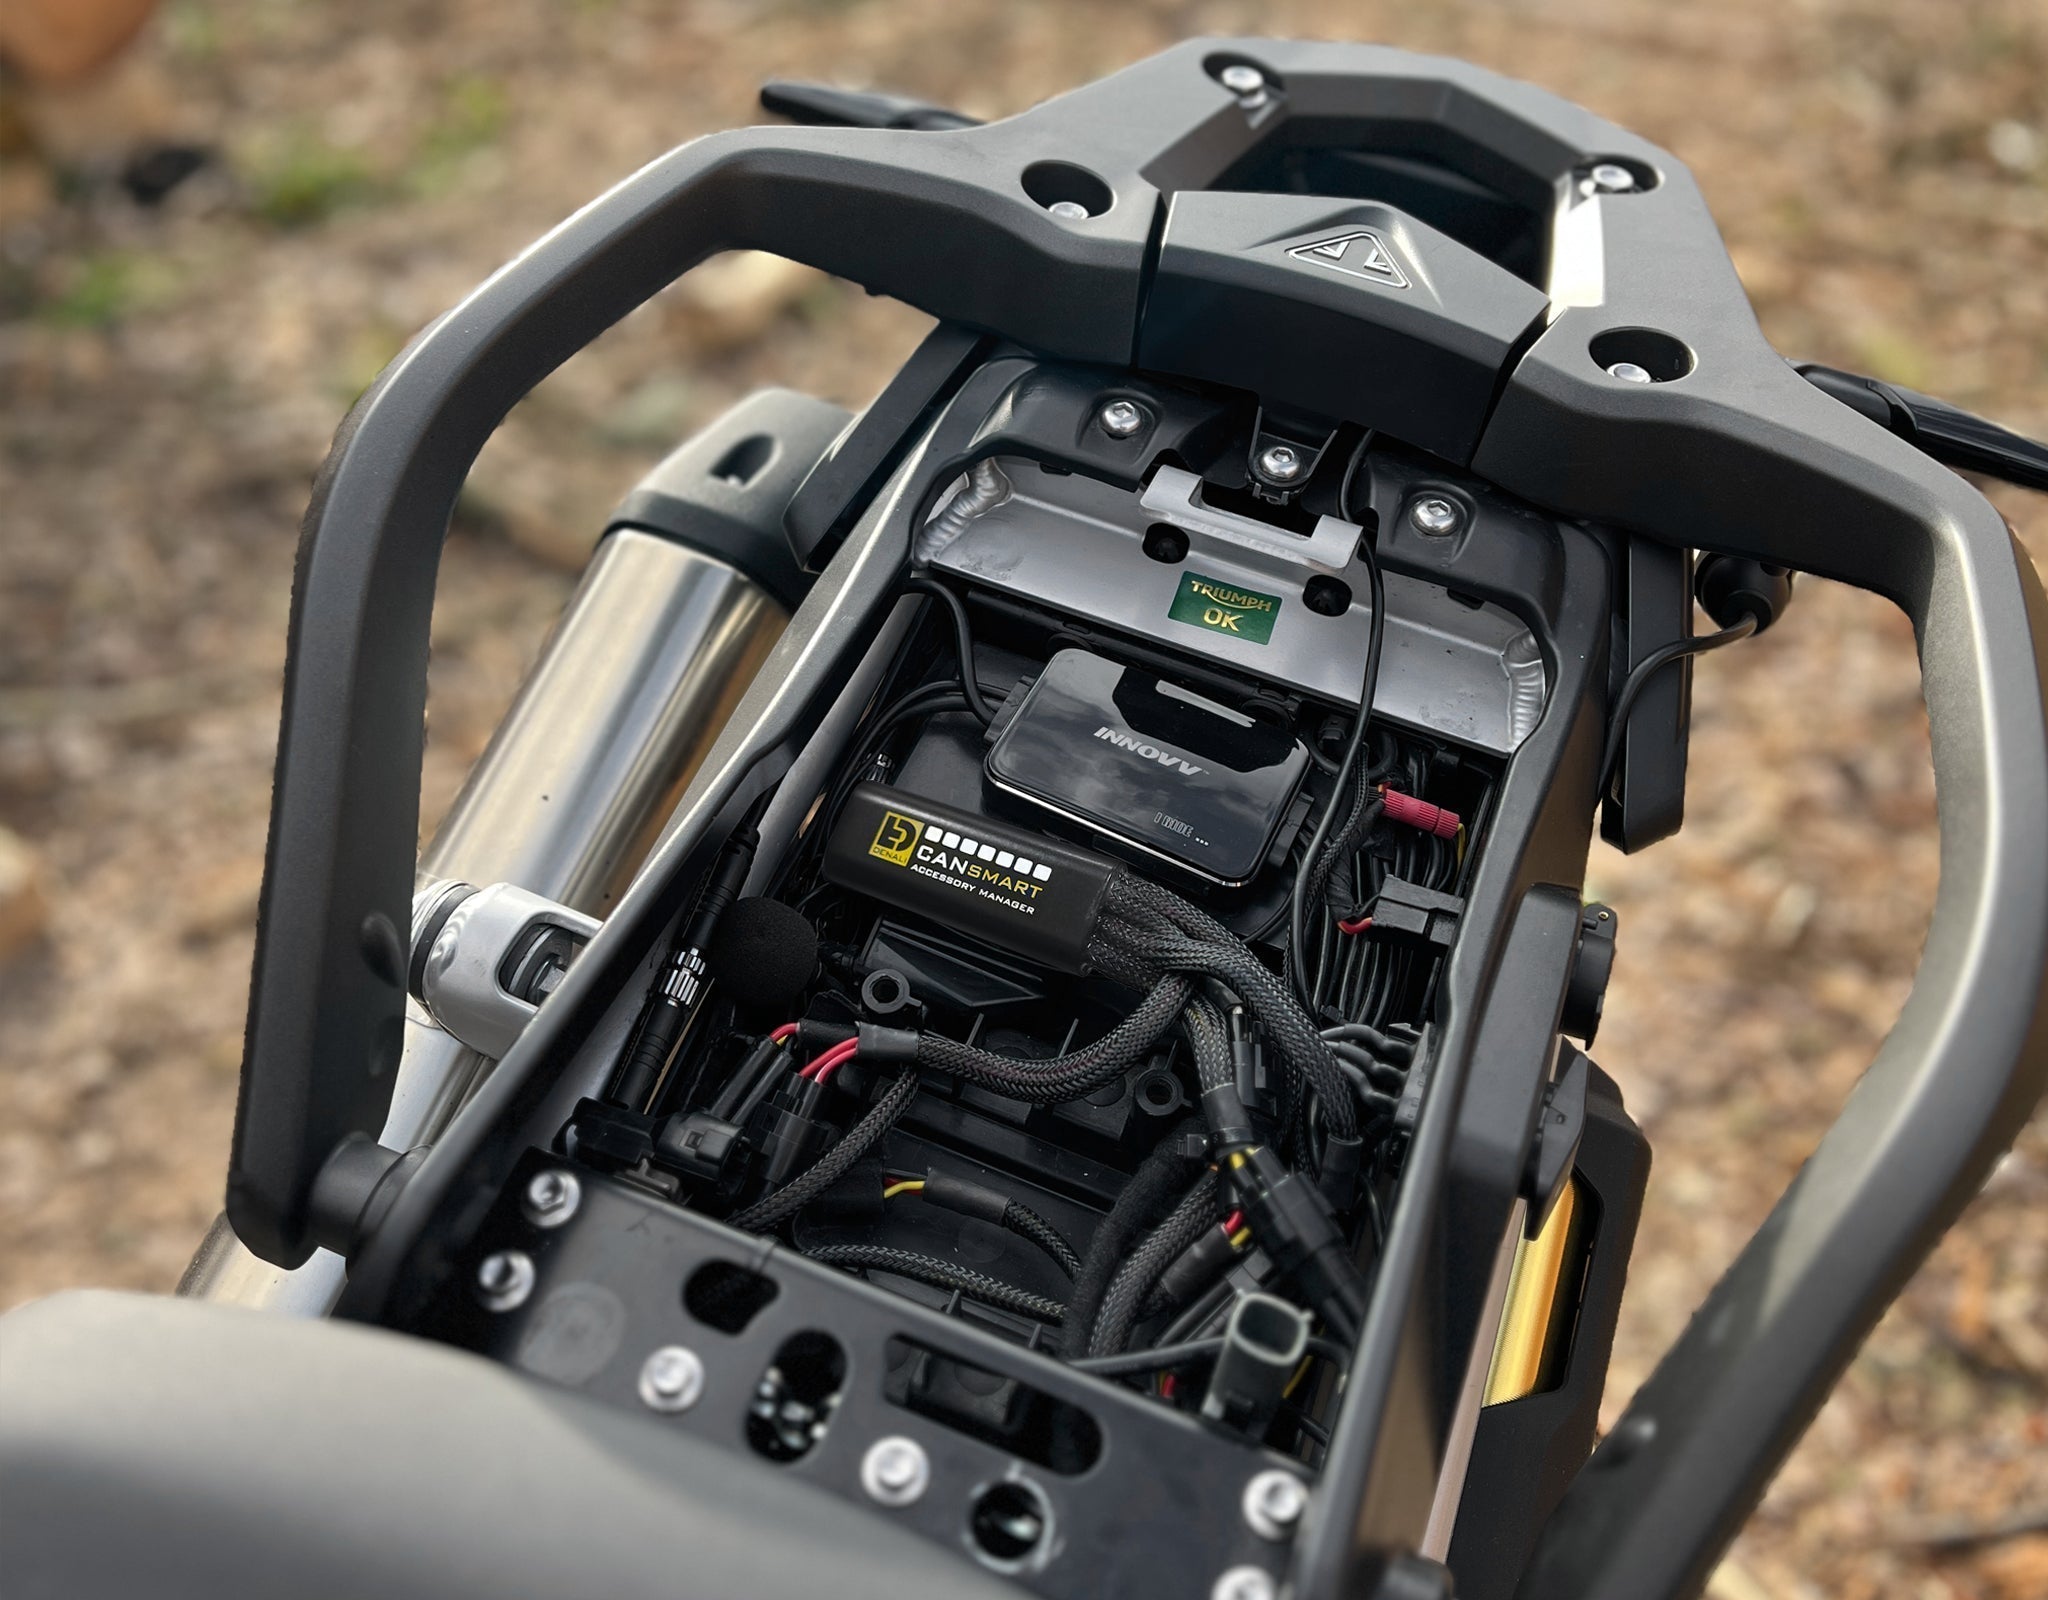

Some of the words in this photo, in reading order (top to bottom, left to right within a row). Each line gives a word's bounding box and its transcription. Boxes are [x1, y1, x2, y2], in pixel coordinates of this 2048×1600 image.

[1191, 580, 1272, 612] TRIUMPH
[1203, 608, 1244, 632] OK
[1093, 726, 1202, 775] INNOVV
[872, 847, 908, 863] DENALI
[916, 845, 1043, 899] CANSMART
[910, 864, 976, 892] ACCESSORY
[978, 888, 1035, 915] MANAGER
